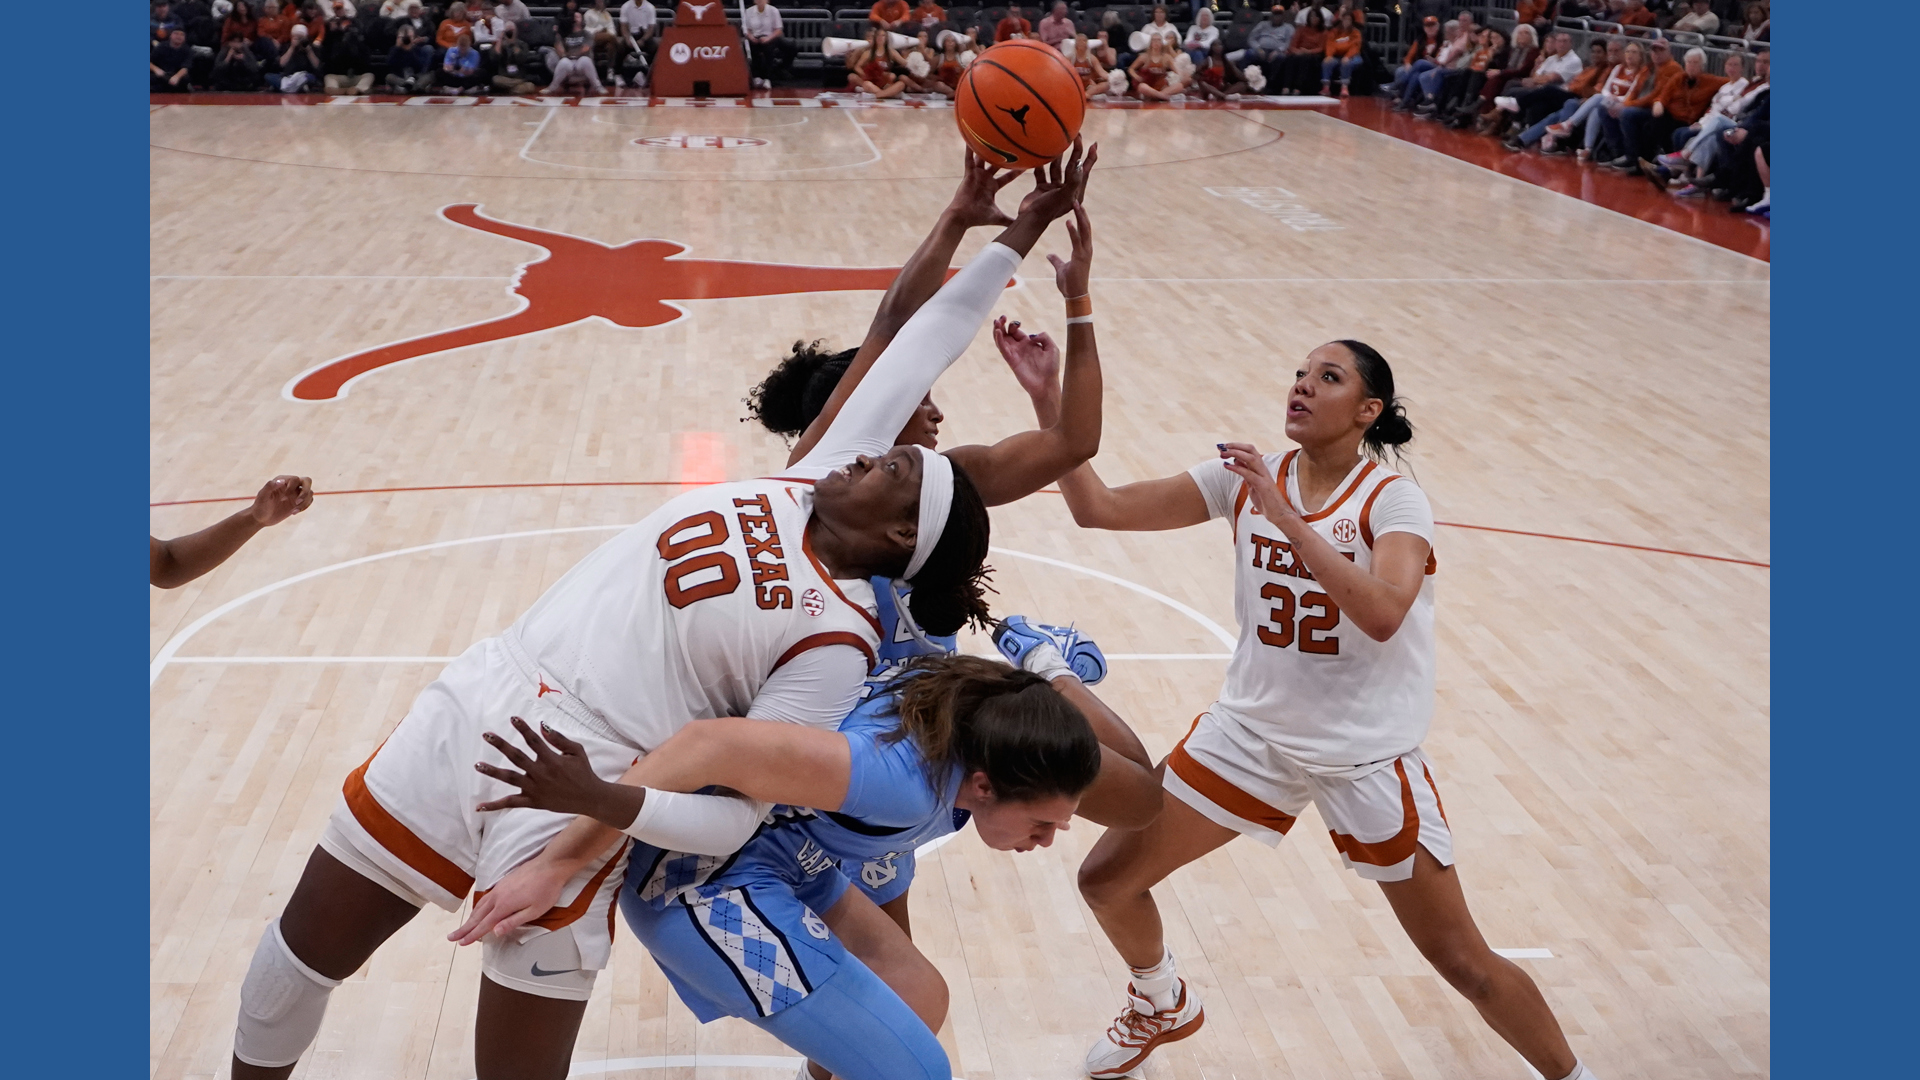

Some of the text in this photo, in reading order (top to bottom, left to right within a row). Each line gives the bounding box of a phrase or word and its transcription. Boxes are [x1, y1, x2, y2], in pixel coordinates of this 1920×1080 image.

[693, 46, 730, 58] razr
[732, 493, 793, 610] TEXAS
[1333, 518, 1357, 543] SEC
[656, 510, 741, 610] 00
[802, 588, 824, 616] SEC
[1257, 582, 1340, 655] 32
